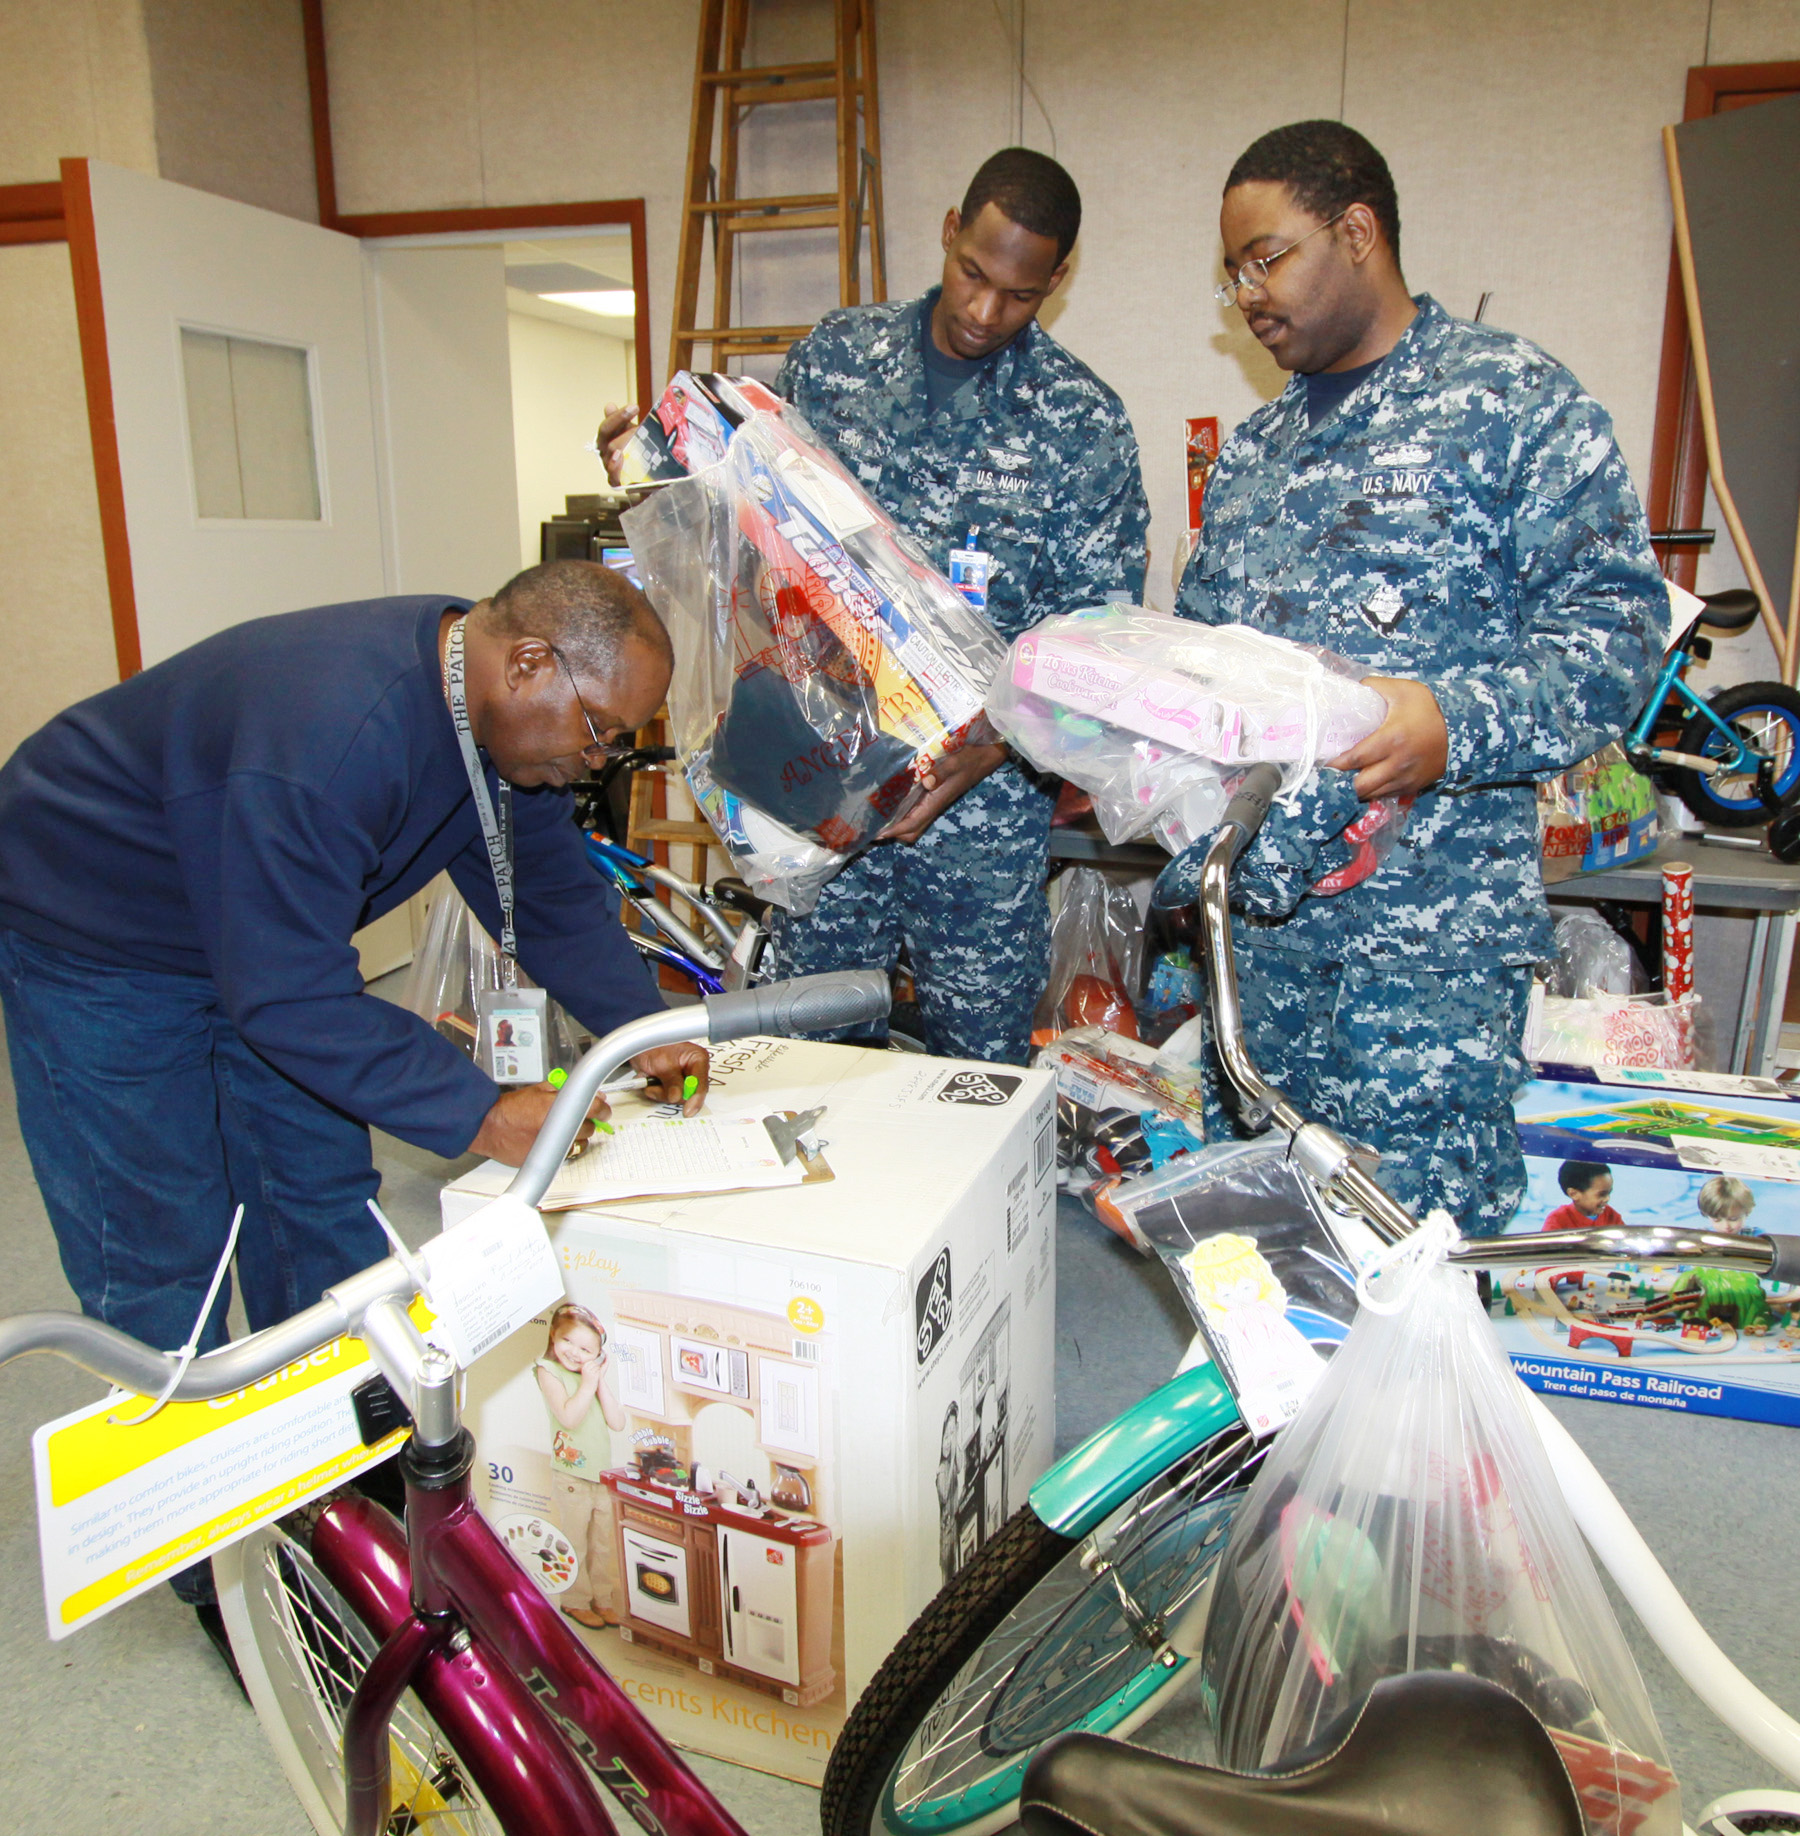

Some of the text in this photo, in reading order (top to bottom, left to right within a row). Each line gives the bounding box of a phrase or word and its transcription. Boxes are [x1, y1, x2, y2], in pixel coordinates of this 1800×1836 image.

[838, 428, 863, 449] LEAK
[977, 470, 1030, 494] U.S. NAVY
[1362, 473, 1433, 495] U.S. NAVY
[909, 634, 939, 666] CAUTION
[450, 622, 471, 736] THE PATCH
[1079, 665, 1121, 690] Kitchen
[875, 663, 950, 726] TREE
[780, 722, 879, 793] ANGEL
[487, 834, 512, 888] PATCH
[1544, 841, 1593, 857] NEWS
[711, 1039, 773, 1075] Fresh
[954, 1072, 1009, 1104] STEP
[574, 1249, 621, 1278] play
[789, 1279, 822, 1293] 706100
[796, 1301, 815, 1315] 2+
[917, 1252, 947, 1359] STEP
[609, 1343, 629, 1354] Ring
[619, 1352, 637, 1363] Ring
[1514, 1360, 1596, 1382] Mountain
[1601, 1371, 1641, 1388] Pass
[1647, 1377, 1723, 1400] Railroad
[1543, 1380, 1687, 1408] Tren del paso de montaña
[628, 1427, 655, 1445] Bubble
[642, 1435, 672, 1448] Bubble
[71, 1508, 114, 1536] Similar
[115, 1503, 127, 1515] to
[128, 1478, 175, 1508] comfort
[177, 1461, 209, 1485] bikes,
[210, 1441, 252, 1468] cruisers
[253, 1433, 271, 1447] are
[271, 1401, 332, 1438] comfortable
[488, 1463, 514, 1483] 30
[67, 1543, 81, 1556] in
[82, 1520, 127, 1551] design.
[127, 1504, 157, 1528] They
[157, 1482, 201, 1513] provide
[202, 1477, 218, 1488] an
[219, 1453, 261, 1483] upright
[261, 1438, 289, 1462] riding
[289, 1415, 336, 1447] position.
[85, 1534, 133, 1567] making
[133, 1516, 167, 1540] them
[167, 1504, 198, 1523] more
[198, 1469, 264, 1510] appropriate
[264, 1460, 279, 1474] for
[280, 1445, 310, 1469] riding
[310, 1430, 337, 1451] short
[675, 1491, 701, 1505] Sizzle
[683, 1502, 709, 1516] Sizzle
[124, 1534, 205, 1586] Remember,
[207, 1508, 254, 1543] always
[255, 1494, 286, 1515] wear
[297, 1462, 340, 1493] helmet
[711, 1694, 832, 1750] Kitchen
